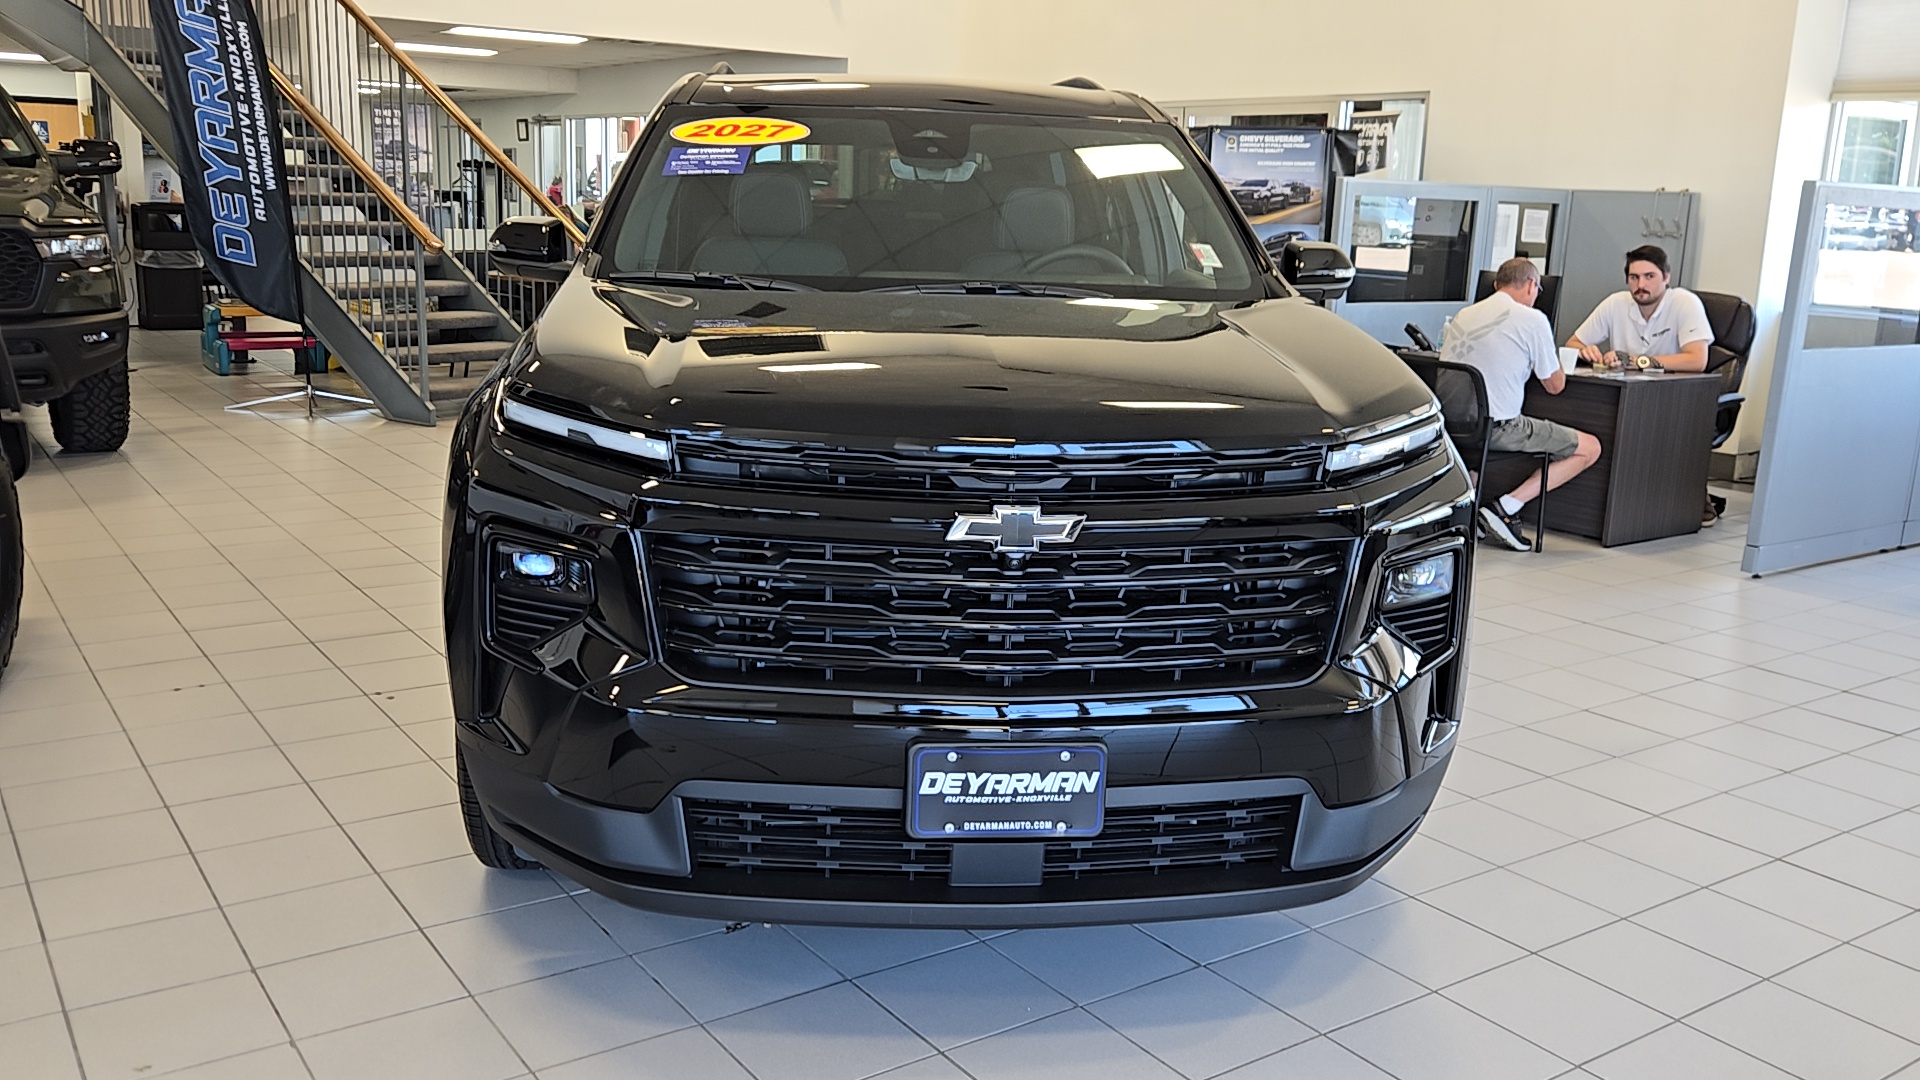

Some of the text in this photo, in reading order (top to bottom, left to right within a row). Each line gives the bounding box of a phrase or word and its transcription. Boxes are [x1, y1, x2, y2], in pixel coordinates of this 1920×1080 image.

[236, 21, 277, 191] WWW.DEYARMANAUTO.COM
[684, 124, 796, 138] 2027
[1239, 134, 1305, 143] CHEVY SILVERADO
[918, 771, 1101, 795] DEYARMAN
[963, 821, 1053, 831] DEYARMANAUTO.COM
